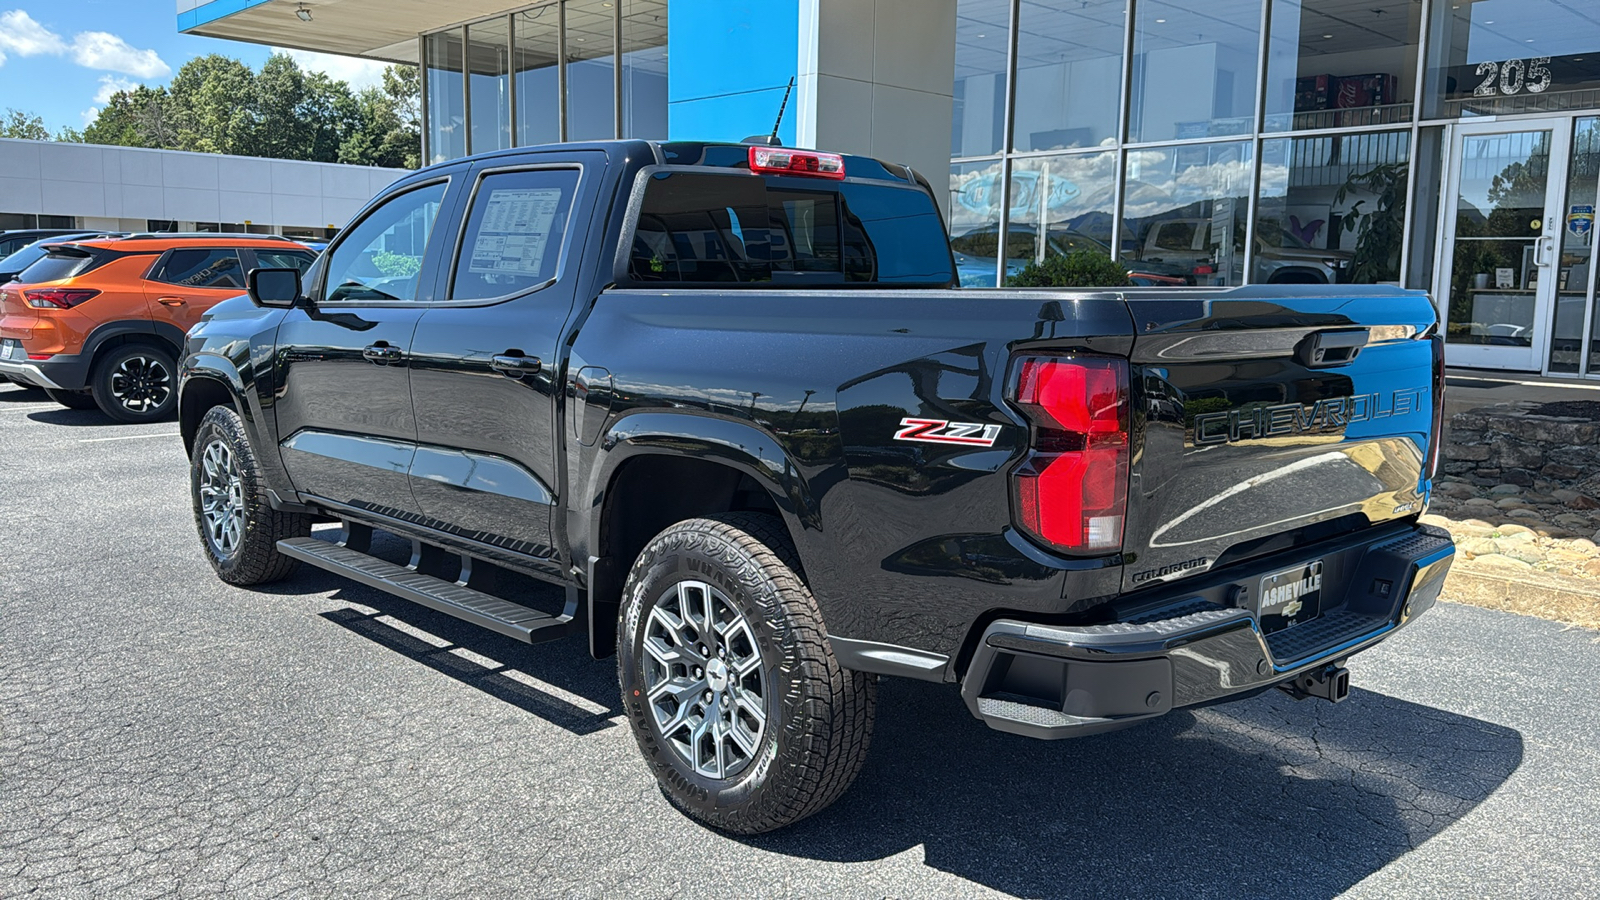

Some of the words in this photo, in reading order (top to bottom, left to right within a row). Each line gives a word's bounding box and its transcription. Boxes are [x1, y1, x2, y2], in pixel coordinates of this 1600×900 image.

[1473, 56, 1552, 97] 205
[893, 417, 1003, 447] Z71
[1194, 386, 1429, 446] CHEVROLET
[1132, 557, 1207, 583] COLORADO
[686, 557, 771, 653] WRANGLER
[1261, 574, 1322, 608] ASHEVILLE
